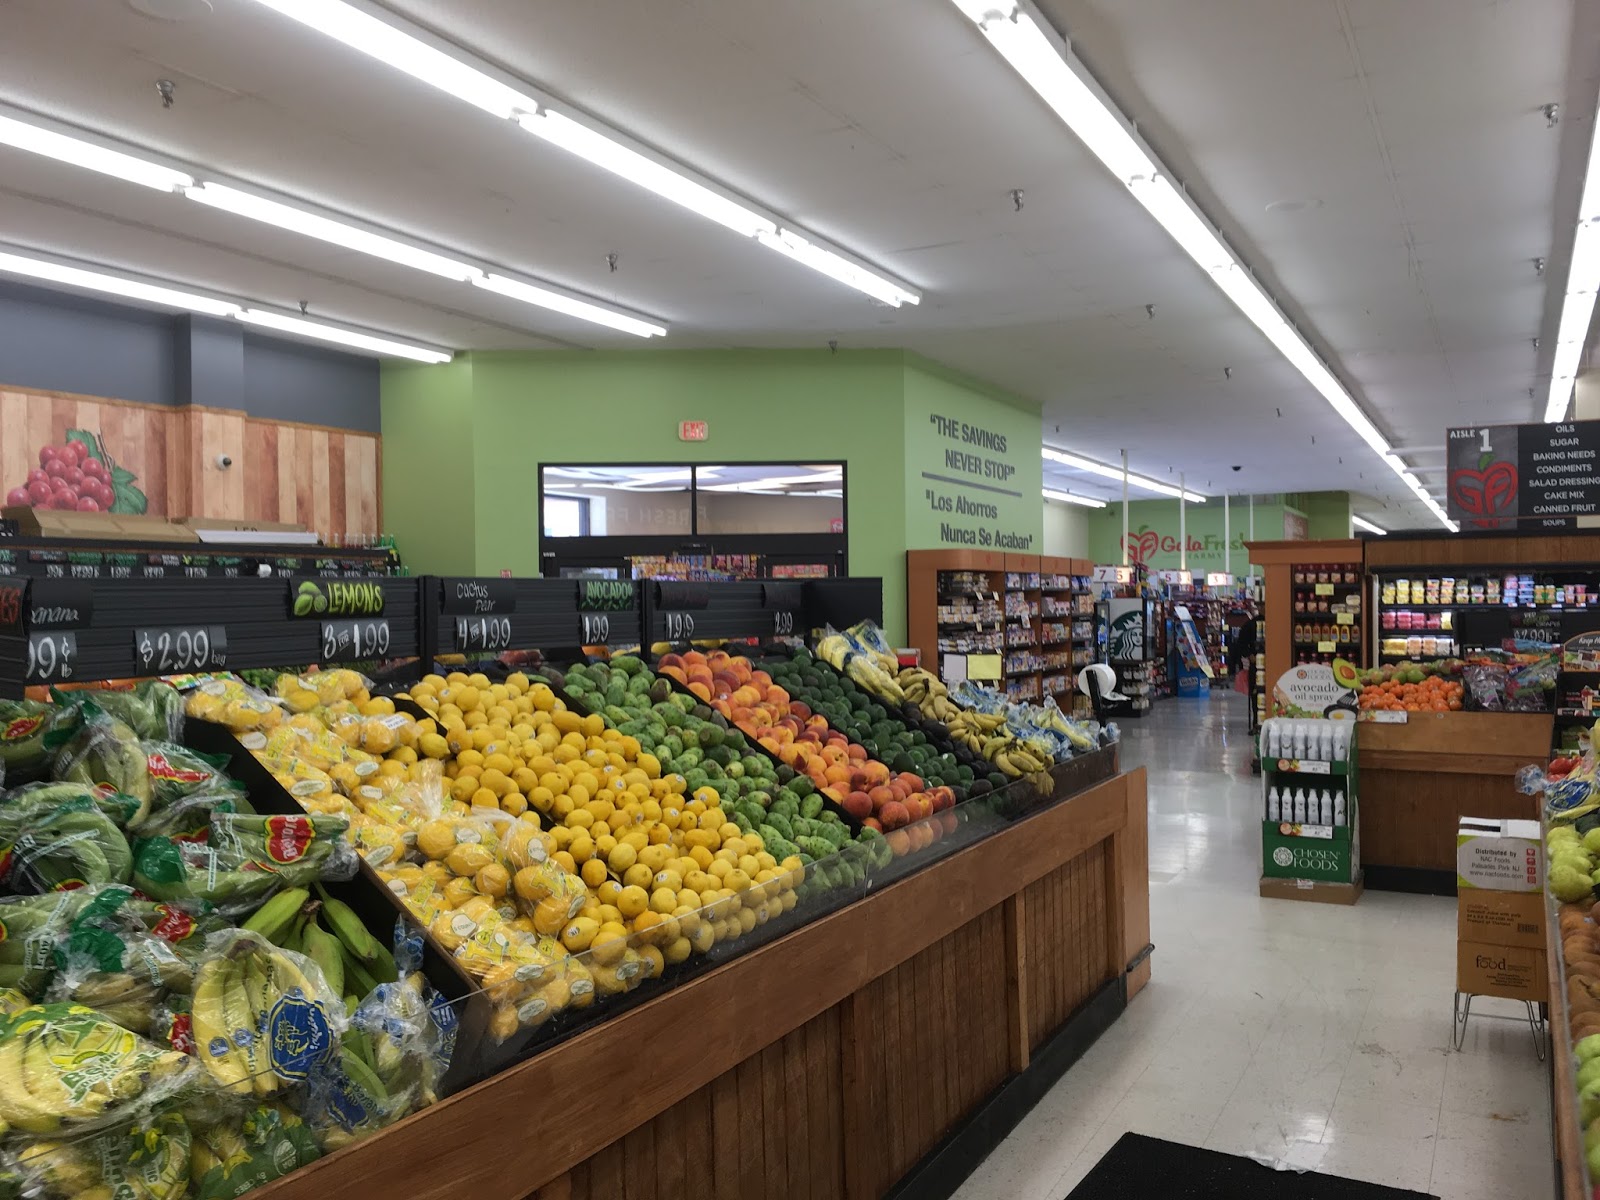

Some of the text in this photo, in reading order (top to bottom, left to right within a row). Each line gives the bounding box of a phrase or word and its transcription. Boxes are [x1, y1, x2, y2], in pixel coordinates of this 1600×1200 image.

[1555, 425, 1575, 433] OILS
[962, 424, 1007, 453] SAVINGS
[1450, 428, 1493, 452] AISLE 1
[1549, 438, 1579, 447] SUGAR
[1533, 450, 1596, 461] BAKING NEEDS
[945, 449, 982, 476] NEVER
[1536, 464, 1592, 474] CONDIMENTS
[1529, 477, 1600, 488] SALAD DRESSING
[1544, 491, 1585, 500] CAKE MIX
[956, 495, 998, 519] Ahorros
[1533, 504, 1596, 514] CANNED FRUIT
[1543, 519, 1566, 527] SOUPS
[940, 523, 976, 545] Nunca
[978, 527, 992, 546] Se
[1099, 569, 1107, 580] 7
[327, 581, 383, 614] LEMONS
[458, 618, 468, 649] 4
[481, 618, 511, 649] 1.99
[585, 615, 609, 644] 1.99
[324, 624, 336, 659] 3
[353, 622, 390, 658] 1.99
[61, 662, 73, 678] lb
[1290, 682, 1339, 693] avocado
[1295, 693, 1334, 703] oil spray
[1293, 848, 1338, 860] CHOSEN
[1475, 848, 1507, 856] Distributed
[1293, 857, 1339, 871] FOODS
[1476, 955, 1506, 970] food
[281, 1155, 297, 1169] SDA
